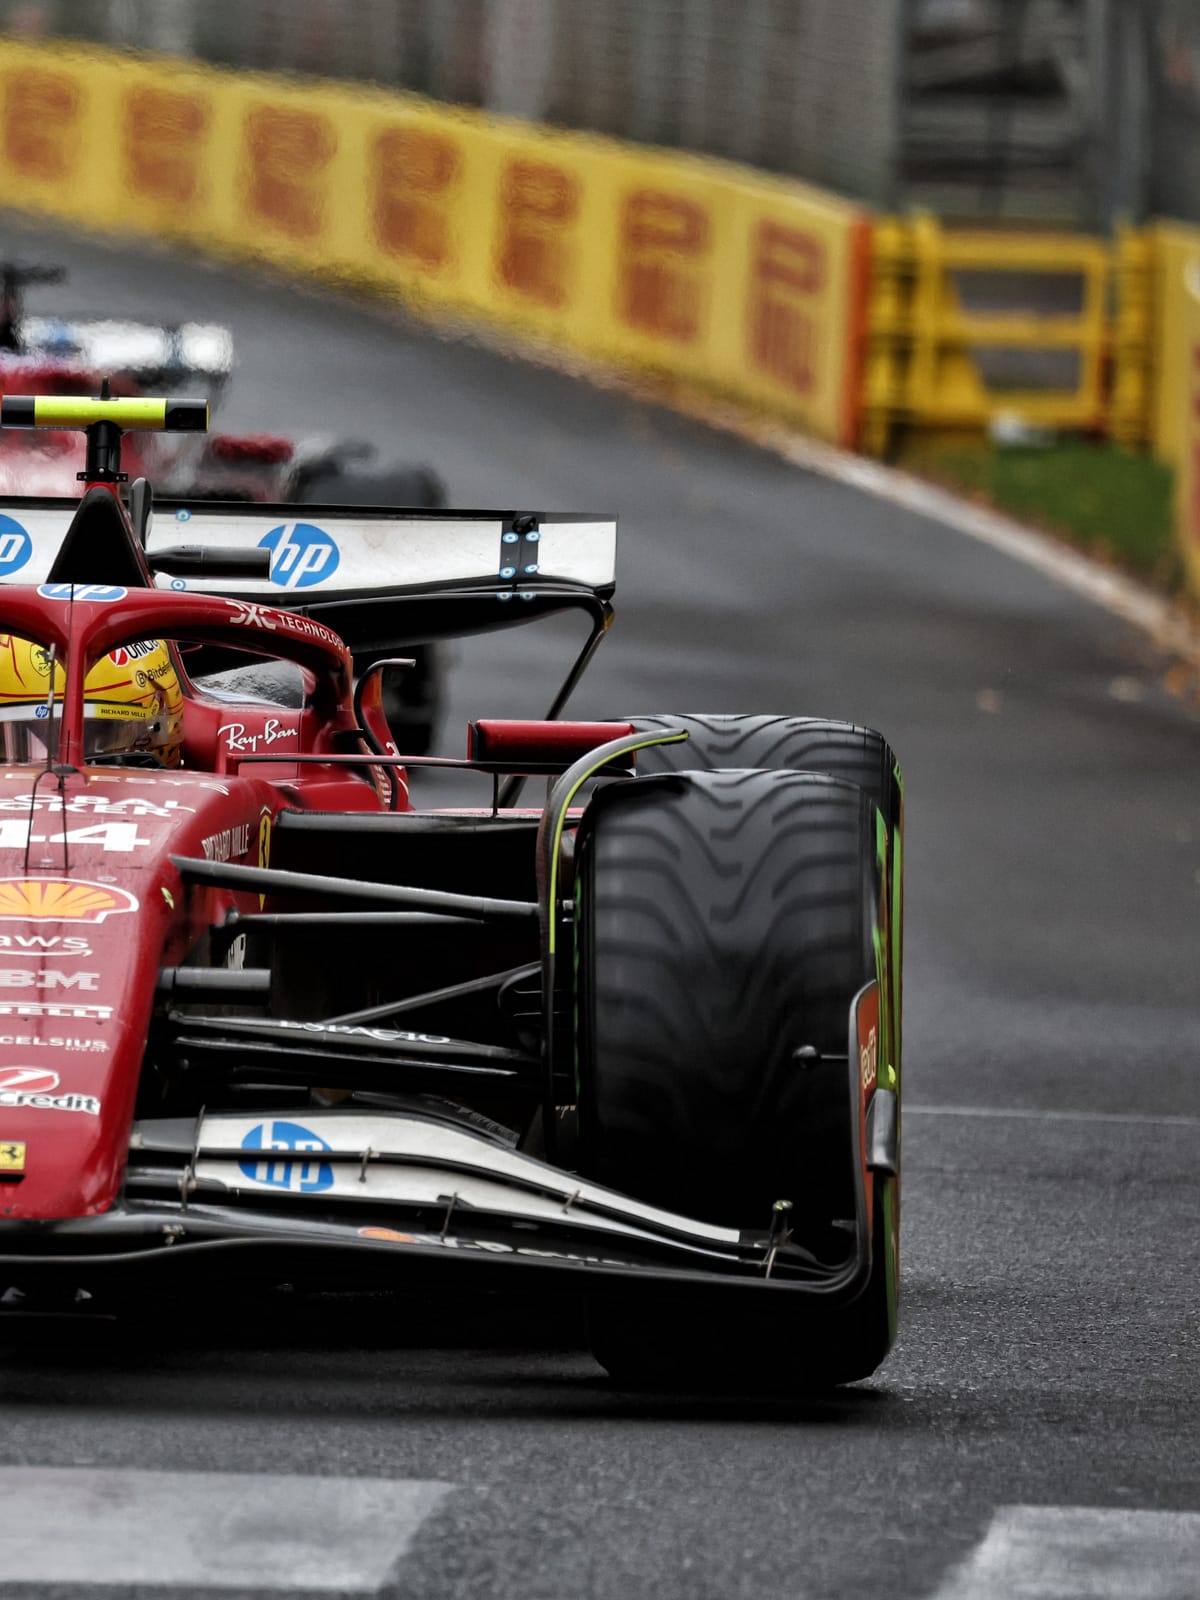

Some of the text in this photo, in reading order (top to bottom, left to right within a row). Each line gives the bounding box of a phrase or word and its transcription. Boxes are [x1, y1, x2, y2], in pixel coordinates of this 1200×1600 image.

[270, 523, 334, 588] hp
[217, 719, 299, 752] Ray-Ban
[254, 1121, 324, 1192] hp
